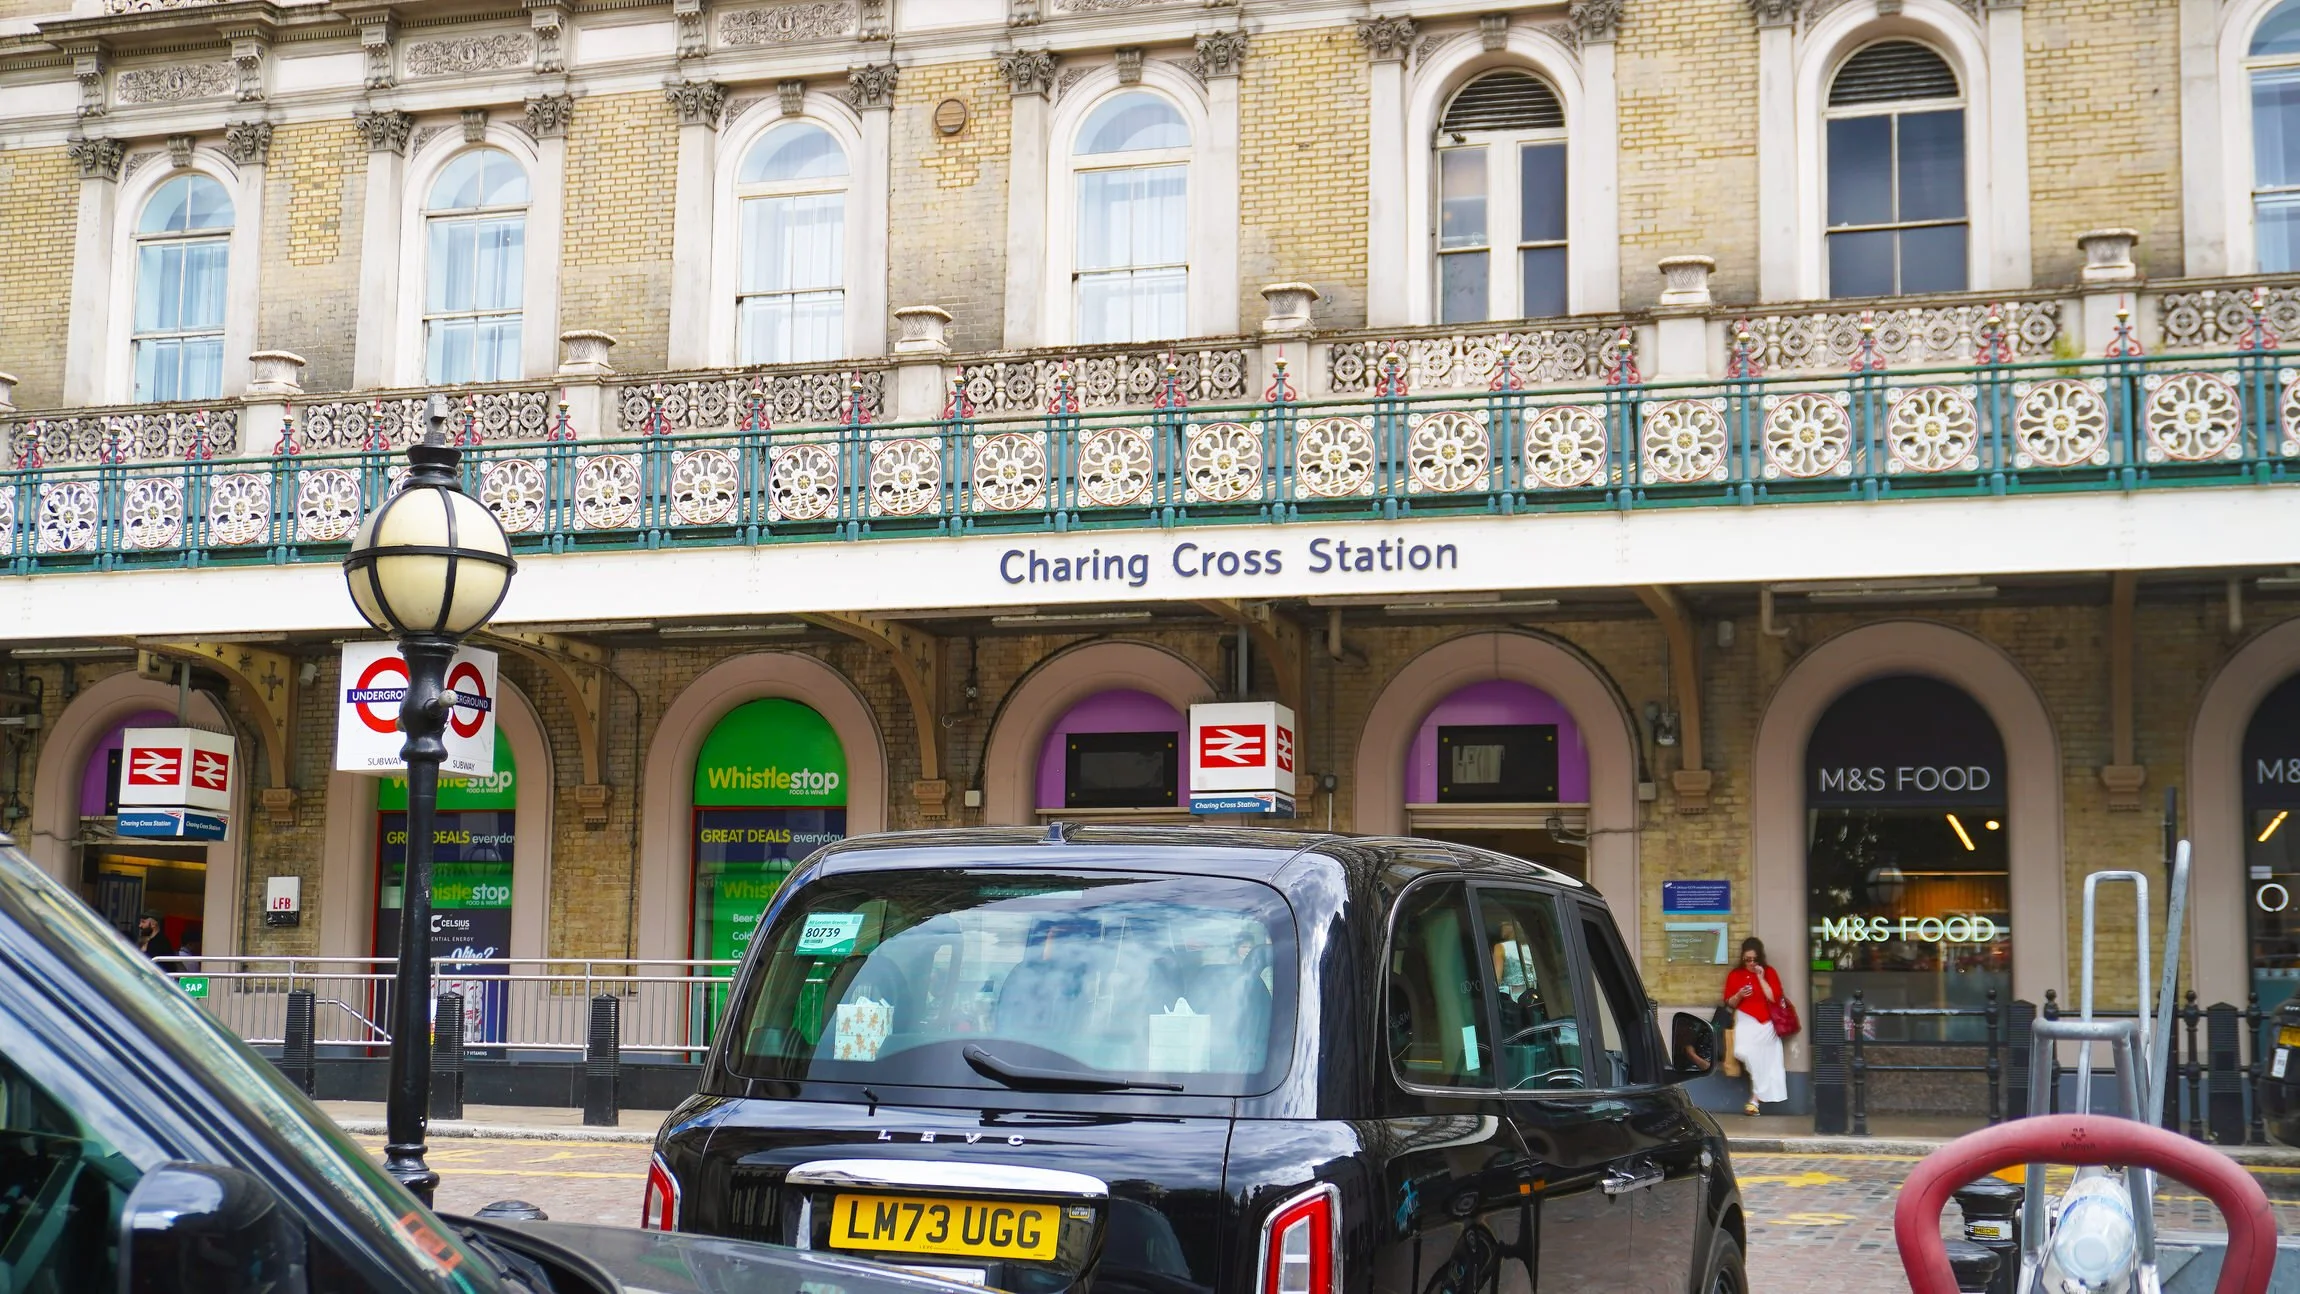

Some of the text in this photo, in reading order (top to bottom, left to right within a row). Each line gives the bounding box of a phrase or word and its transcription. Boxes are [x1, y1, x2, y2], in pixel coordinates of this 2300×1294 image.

[1000, 537, 1458, 587] Charing Cross Station
[352, 690, 406, 701] UNDERGRO
[456, 694, 489, 709] ERGROUND
[367, 757, 402, 766] SUBWAY
[453, 760, 475, 771] SUBWAY
[708, 766, 839, 795] Whistlestop
[1819, 766, 1990, 792] M&S FOOD
[1195, 802, 1219, 810] Charing
[701, 829, 844, 846] GREAT DEALS everyday
[273, 897, 291, 910] LFB
[441, 919, 470, 927] CELSIUS
[733, 914, 754, 923] Beer
[805, 927, 841, 938] 80739
[1822, 916, 1996, 942] M&S FOOD
[184, 983, 203, 992] SAP
[877, 1128, 1025, 1146] LEVC
[847, 1200, 1043, 1249] LM73 UGG
